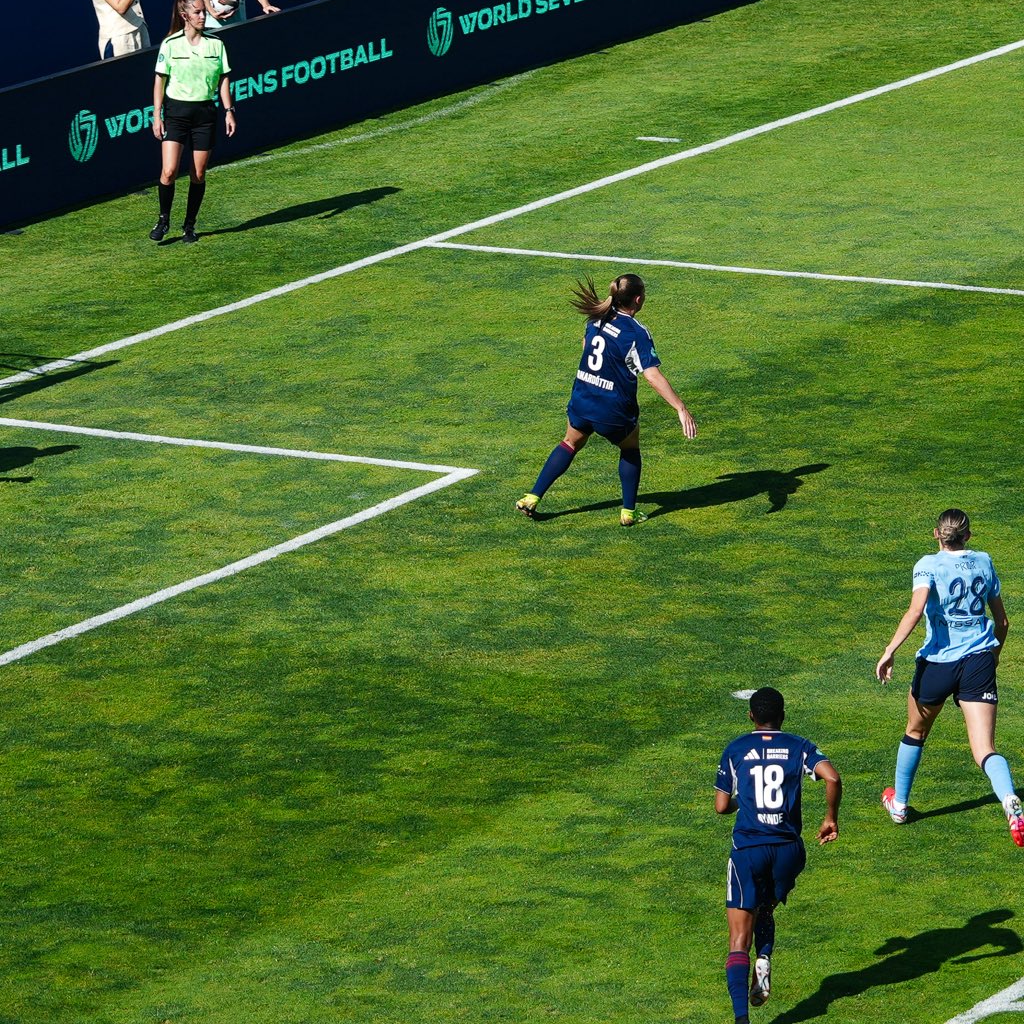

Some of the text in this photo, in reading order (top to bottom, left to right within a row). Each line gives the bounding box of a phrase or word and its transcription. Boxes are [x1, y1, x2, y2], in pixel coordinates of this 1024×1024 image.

[105, 103, 165, 138] WOR
[281, 38, 393, 88] FOOTBALL
[587, 335, 606, 371] 3
[948, 576, 987, 616] 28
[938, 618, 983, 629] NISSA
[749, 764, 784, 809] 18
